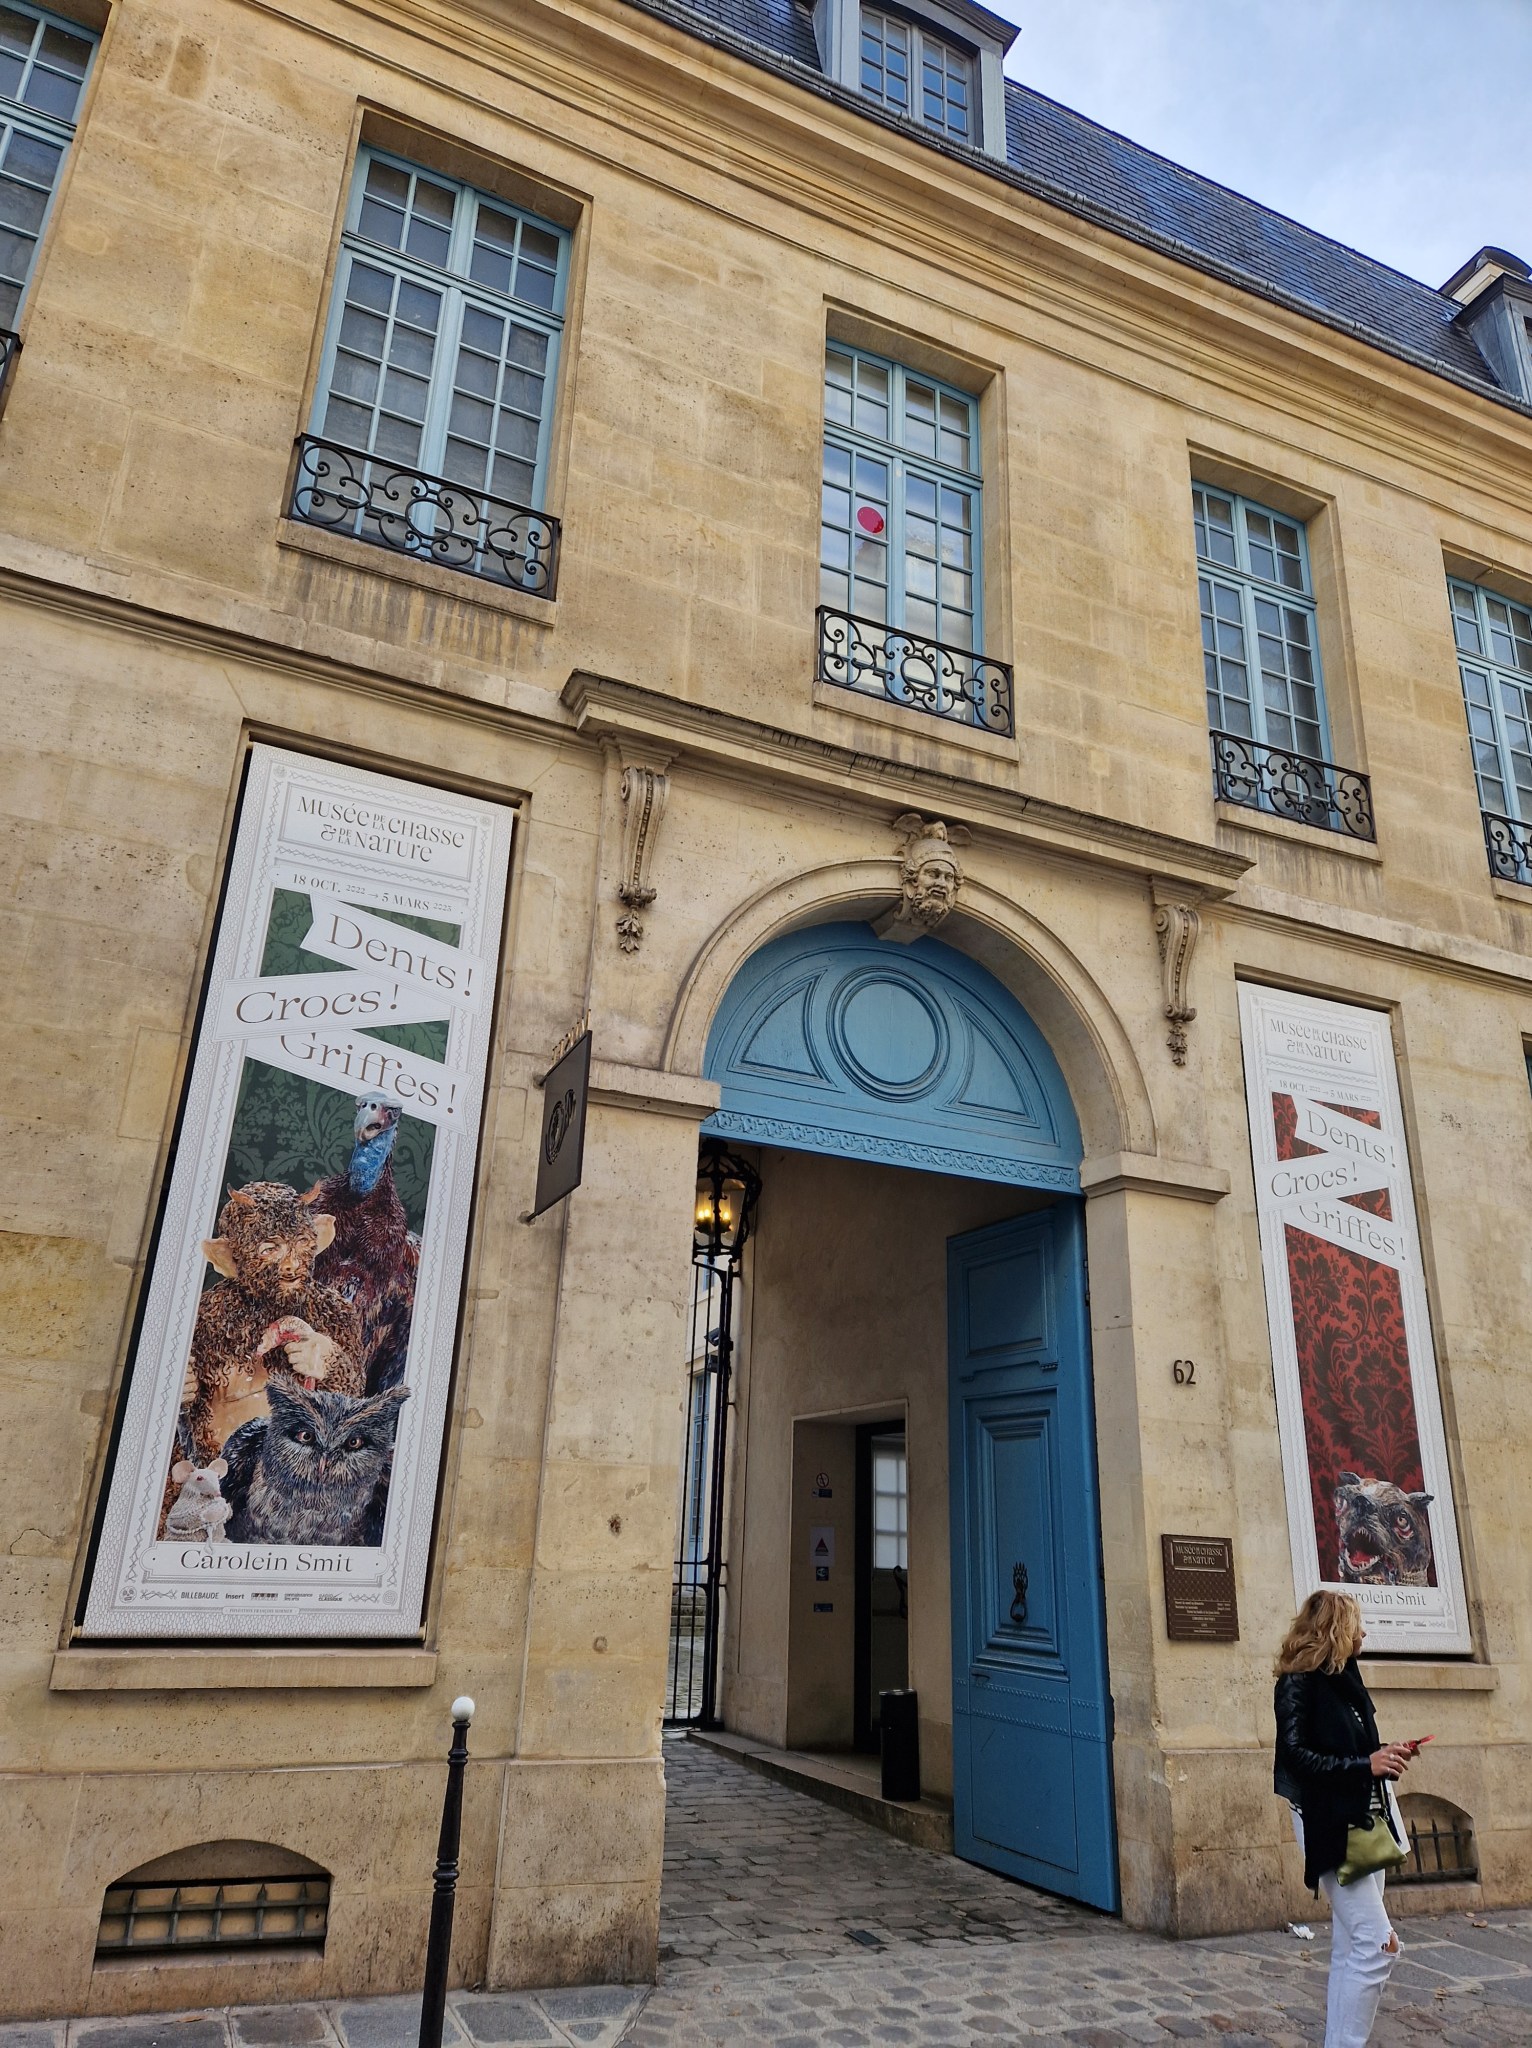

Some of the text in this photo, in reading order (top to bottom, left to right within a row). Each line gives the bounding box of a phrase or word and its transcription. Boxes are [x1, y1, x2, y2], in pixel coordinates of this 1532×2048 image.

[373, 813, 386, 823] DE
[372, 821, 385, 831] LA
[320, 823, 337, 841] &
[339, 827, 352, 837] DE
[338, 835, 351, 845] LA
[293, 873, 307, 885] 18
[310, 877, 341, 893] OCT.
[381, 892, 389, 902] 5
[393, 894, 430, 911] MARS
[1336, 1091, 1359, 1102] MARS
[1173, 1359, 1196, 1384] 62
[180, 1549, 354, 1573] Carolein Smit
[181, 1591, 220, 1600] BILLEBAUDE
[1396, 1591, 1427, 1606] Smit
